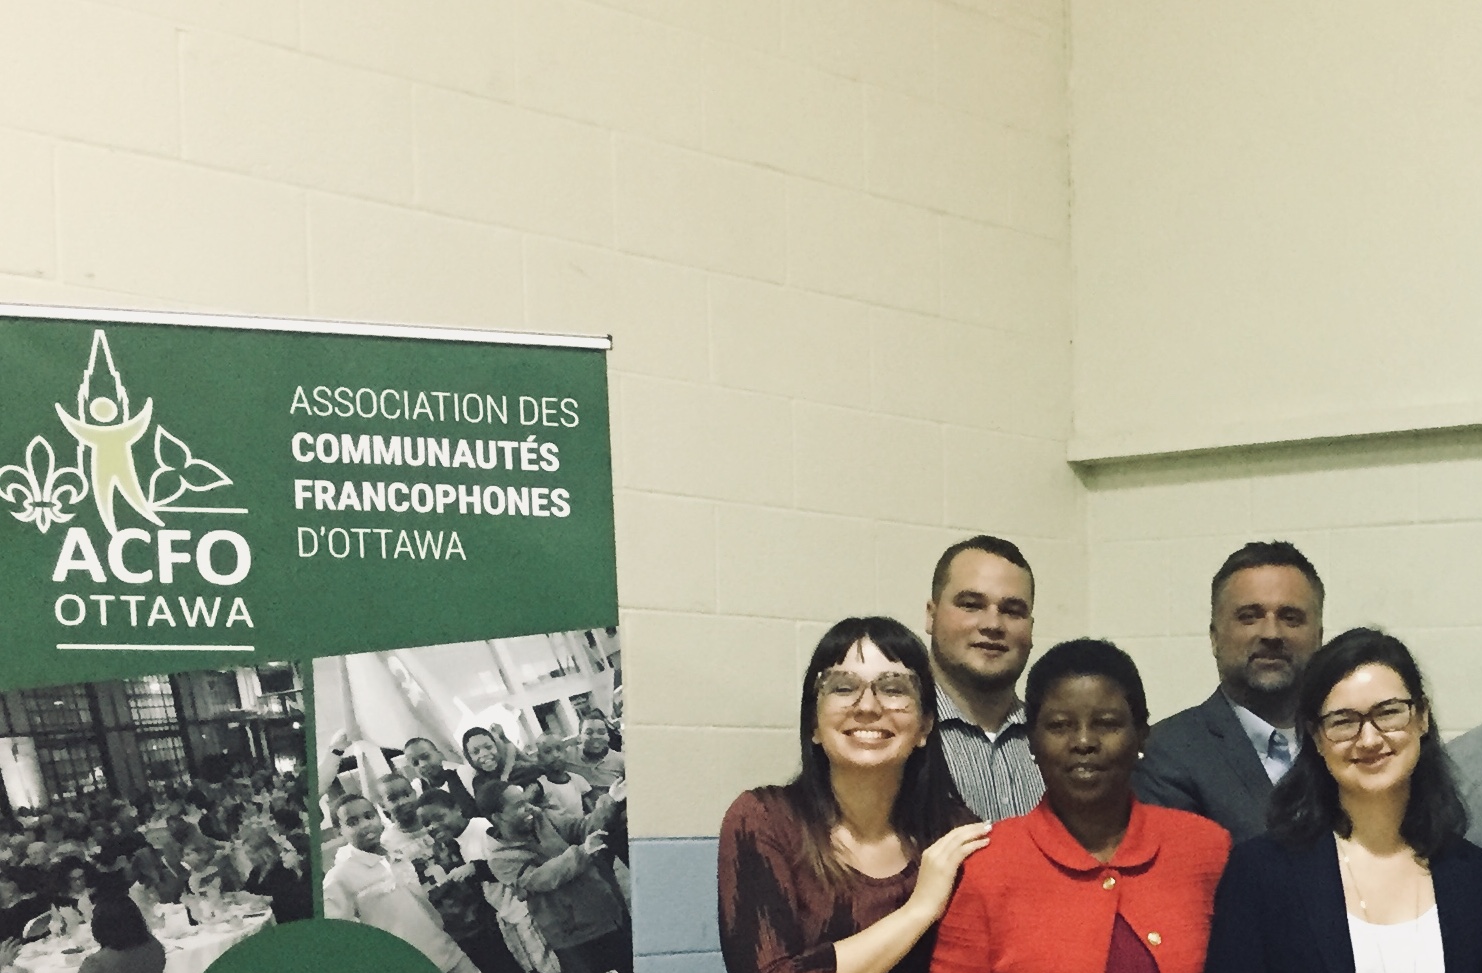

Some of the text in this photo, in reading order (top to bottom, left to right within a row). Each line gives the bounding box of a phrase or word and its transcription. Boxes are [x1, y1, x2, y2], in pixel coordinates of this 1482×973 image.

[290, 385, 580, 428] ASSOCIATION DES
[291, 431, 560, 472] COMMUNAUTÉS
[294, 479, 571, 518] FRANCOPHONES
[52, 527, 252, 586] ACFO
[54, 593, 255, 628] OTTAWA
